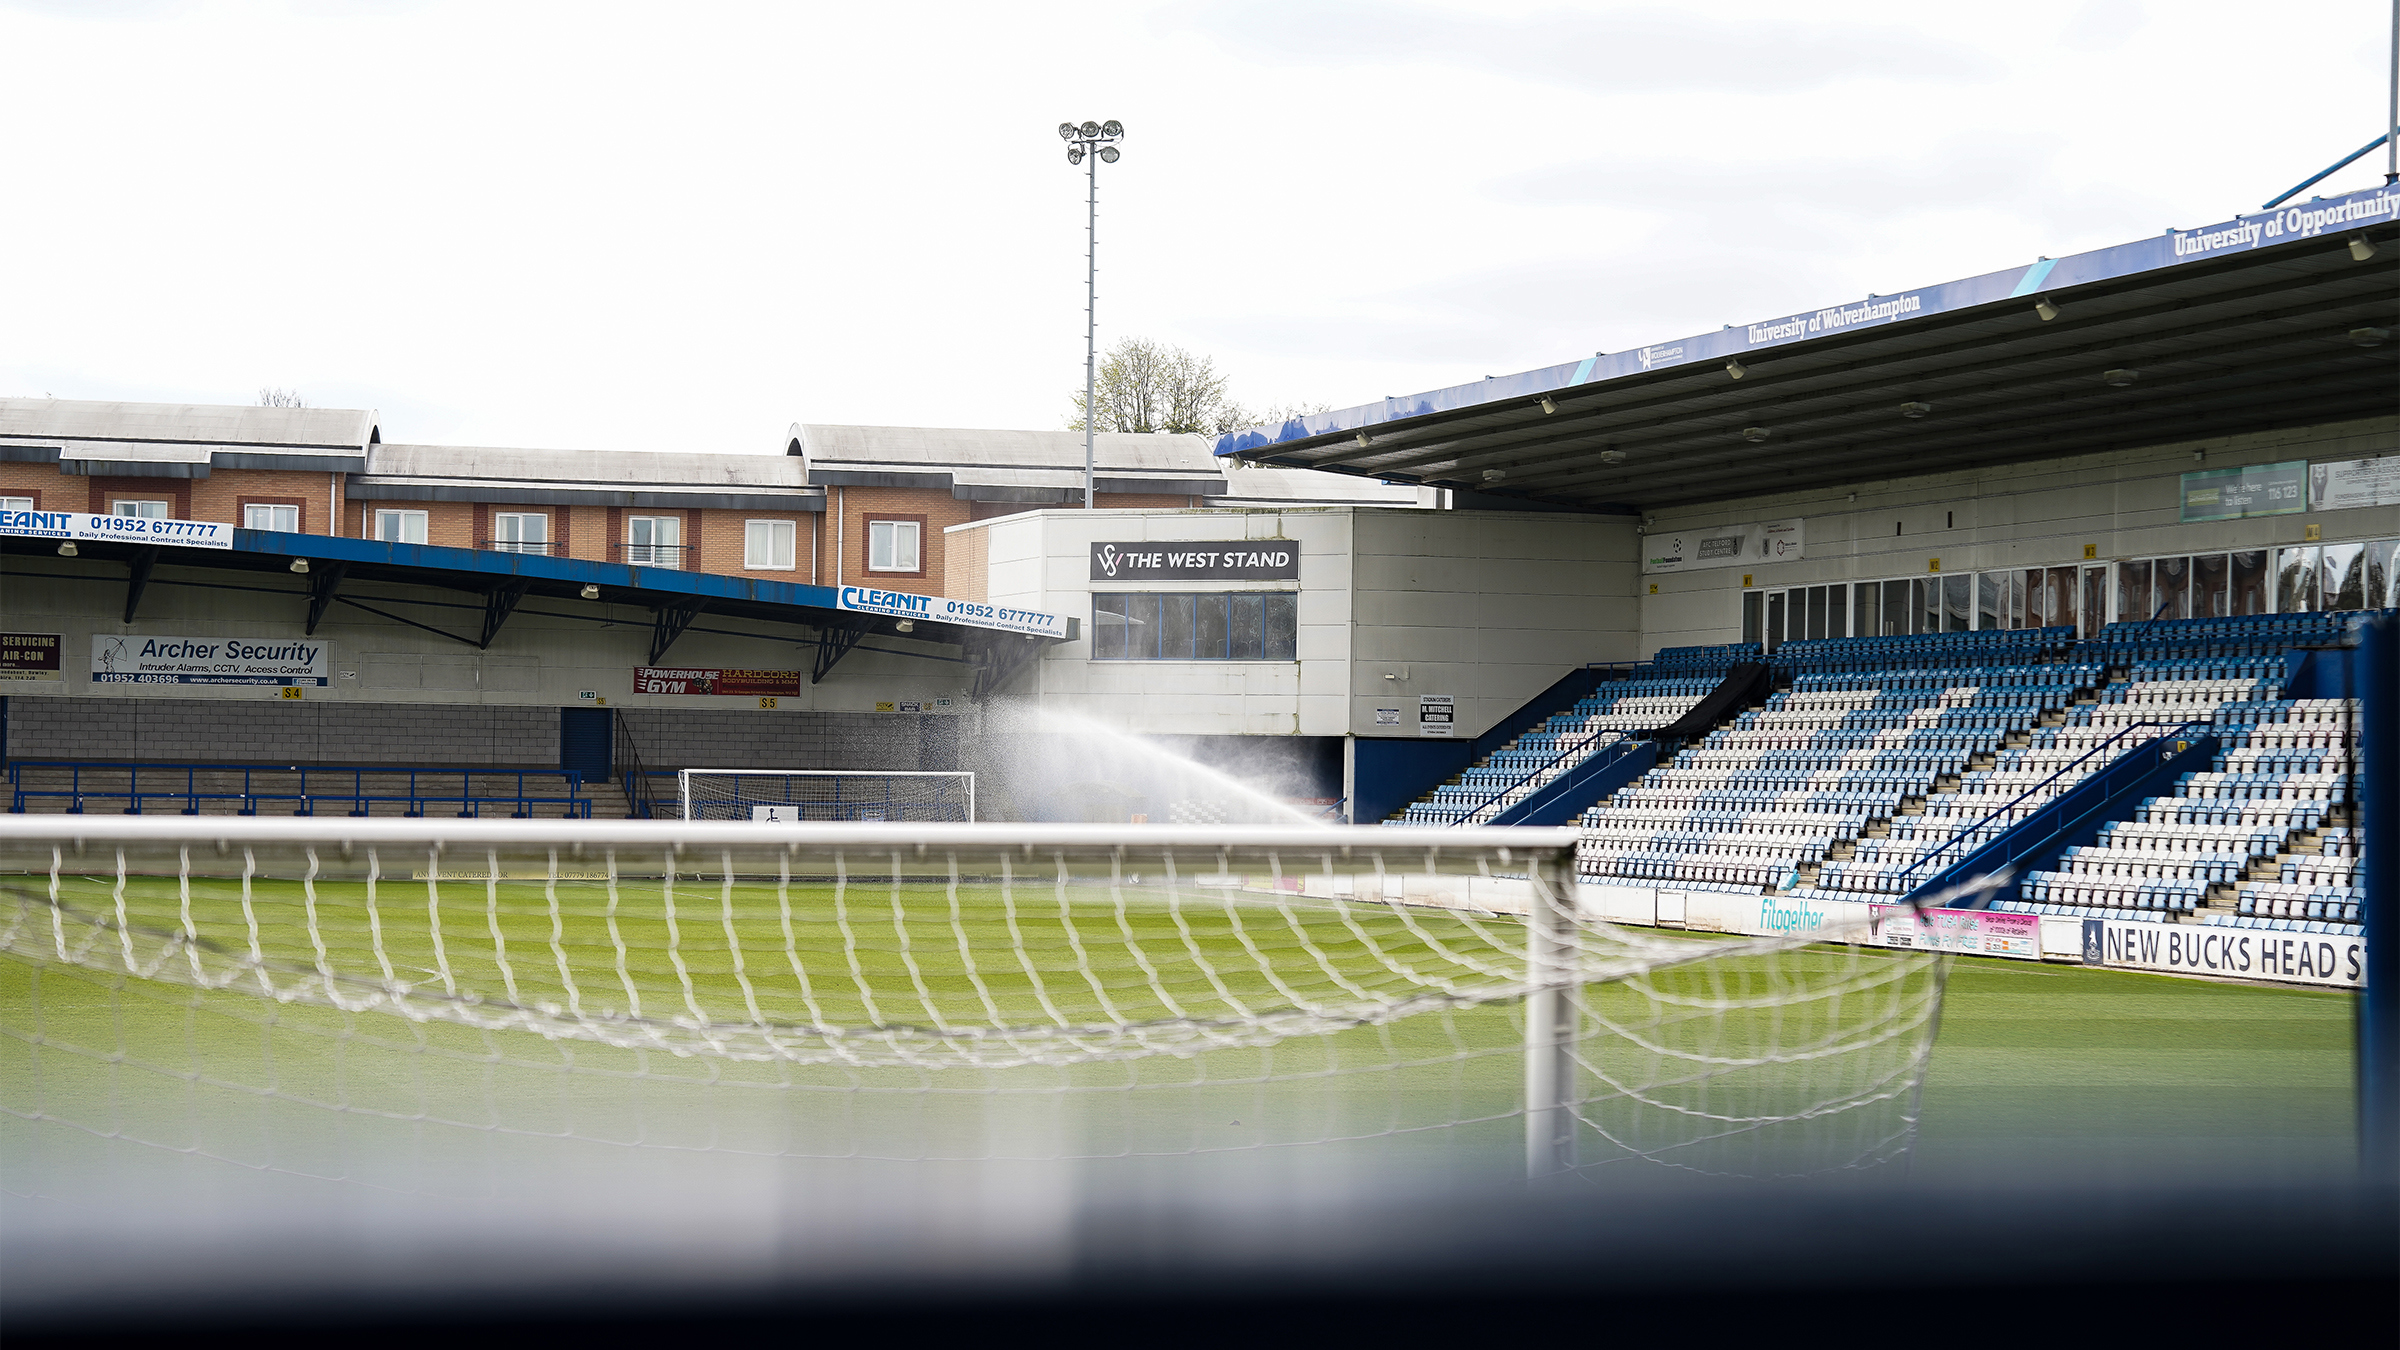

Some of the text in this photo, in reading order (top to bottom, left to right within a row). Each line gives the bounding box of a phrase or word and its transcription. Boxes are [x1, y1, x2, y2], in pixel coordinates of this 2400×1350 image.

[2174, 190, 2400, 256] University of Opportunity
[1748, 295, 1921, 344] University of Wolverhampton
[2246, 482, 2262, 492] here
[2268, 485, 2298, 500] 116 123
[2225, 496, 2253, 506] to listen
[91, 516, 146, 532] 01952
[152, 521, 218, 537] 677777
[79, 531, 228, 547] Daily Professional Contract Specialists
[1127, 552, 1290, 568] THE WEST STAND
[842, 587, 1054, 626] CLEANIT 01952 677777
[857, 605, 890, 614] CLEANING
[936, 613, 1062, 636] Daily Professional Contract Specialists
[2, 636, 55, 647] SERVICING
[2, 650, 44, 661] AIR-CON
[140, 639, 318, 666] Archer Security
[139, 663, 313, 675] Intruder Alarms, CCTV, Access Control
[643, 668, 719, 680] POWERHOUSE
[722, 669, 798, 678] HARDCORE
[101, 673, 278, 685] 01952 403696 www.archersecurity.co.uk
[647, 679, 687, 693] GYM
[1956, 935, 1978, 949] FREE
[2107, 927, 2368, 981] NEW BUCKS HEAD S
